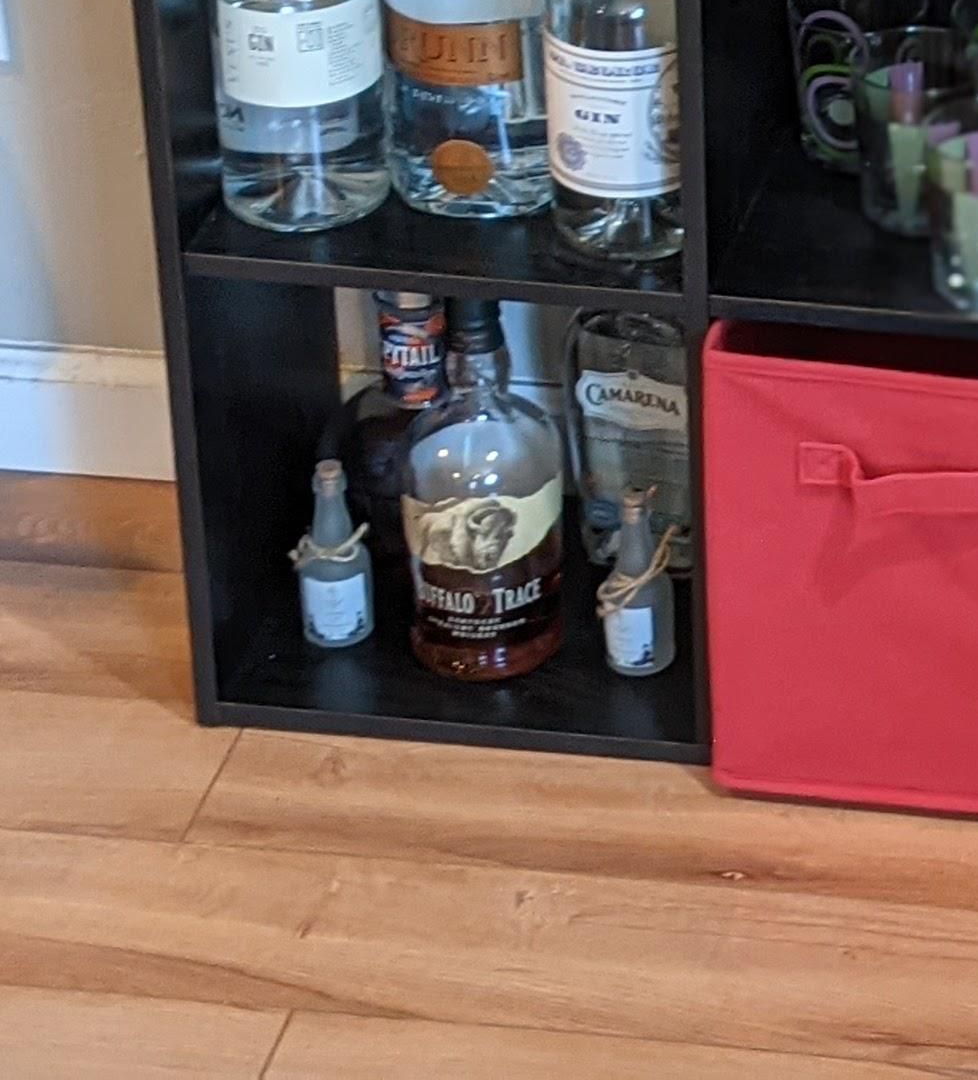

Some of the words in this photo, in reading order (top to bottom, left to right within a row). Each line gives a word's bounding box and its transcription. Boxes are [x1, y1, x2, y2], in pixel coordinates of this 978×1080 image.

[575, 109, 622, 124] GIN
[586, 383, 681, 416] CAMARENA
[492, 577, 542, 614] TRACE
